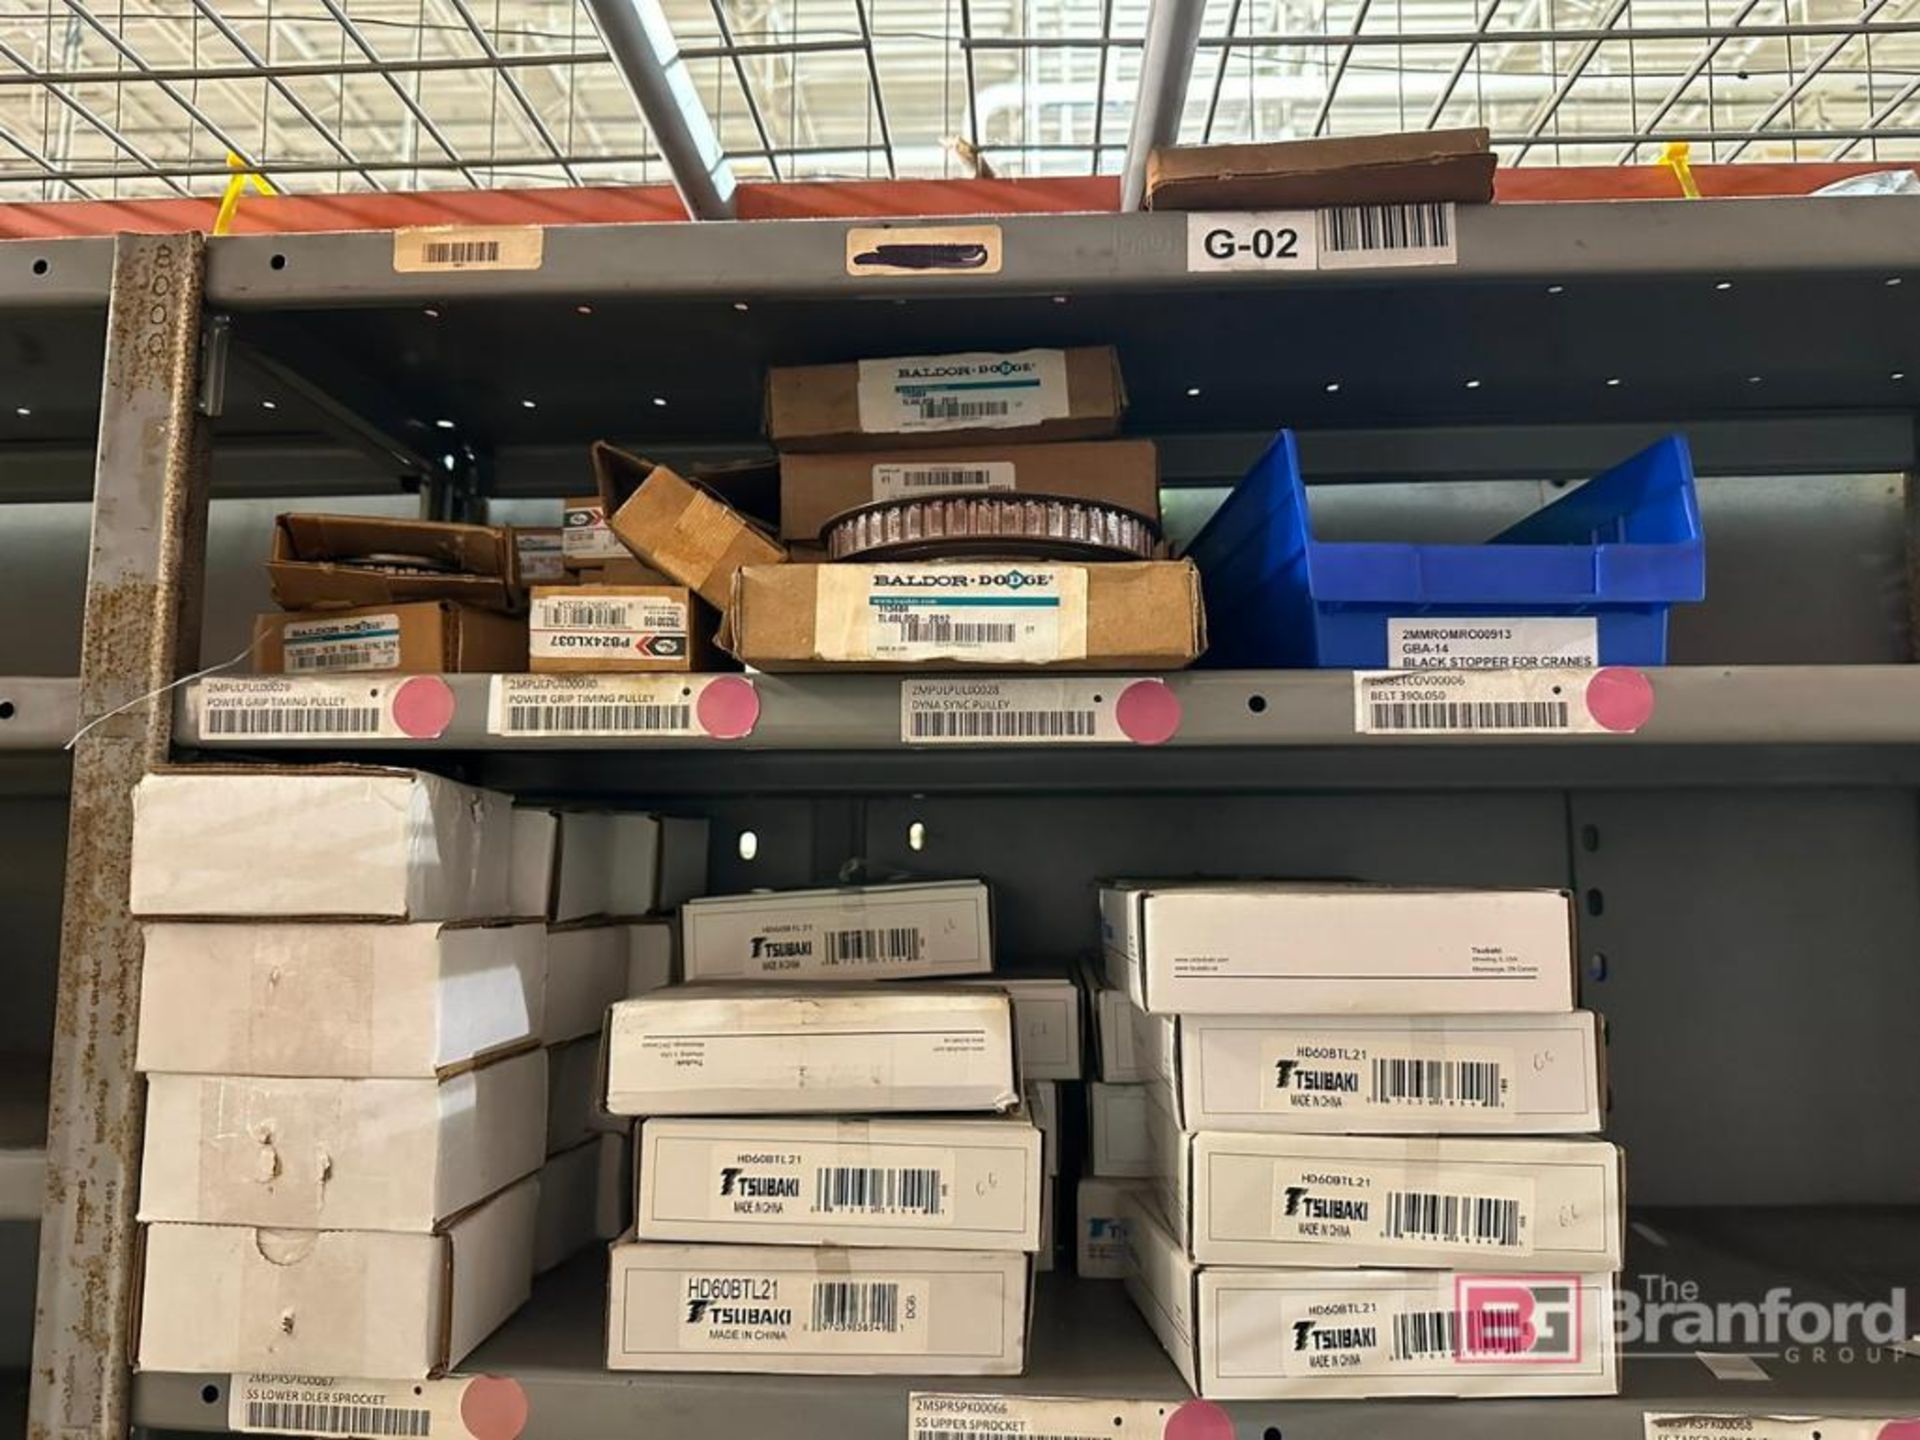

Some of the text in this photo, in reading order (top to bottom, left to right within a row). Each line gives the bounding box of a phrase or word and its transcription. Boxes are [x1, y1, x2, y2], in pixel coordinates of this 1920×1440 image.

[1204, 229, 1298, 259] G-02
[898, 367, 970, 378] BALDOR
[873, 570, 1048, 590] BALDOR DODGE
[1402, 643, 1449, 654] GBA-14
[1403, 656, 1592, 668] BLACK STOPPER FOR CRANES
[207, 697, 346, 707] POWER GRIP TIMING PULLEY
[508, 694, 656, 704] POWER GRIP TIMING PULLEY
[1370, 691, 1396, 701] BELT
[911, 700, 1011, 710] DYNA SYNC PULLEY
[764, 941, 812, 957] TSUBAKI
[1296, 1046, 1367, 1060] HD60BTL21
[1295, 1071, 1358, 1092] TSUBAKI
[737, 1154, 801, 1165] HD60BTL21
[738, 1177, 799, 1197] TSUBAKI
[1301, 1174, 1371, 1187] HD60BTL21
[1303, 1199, 1368, 1221] TSUBAKI
[688, 1278, 779, 1300] HD60BTL21
[1308, 1303, 1377, 1316] HD60BTL21
[710, 1308, 792, 1325] TSUBAKI
[709, 1329, 787, 1340] MADE IN CHINA
[1312, 1328, 1377, 1350] TSUBAKI
[247, 1389, 386, 1406] SS LOWER IDLER SPROCKET
[915, 1418, 1026, 1431] SS UPPER SPROCKET
